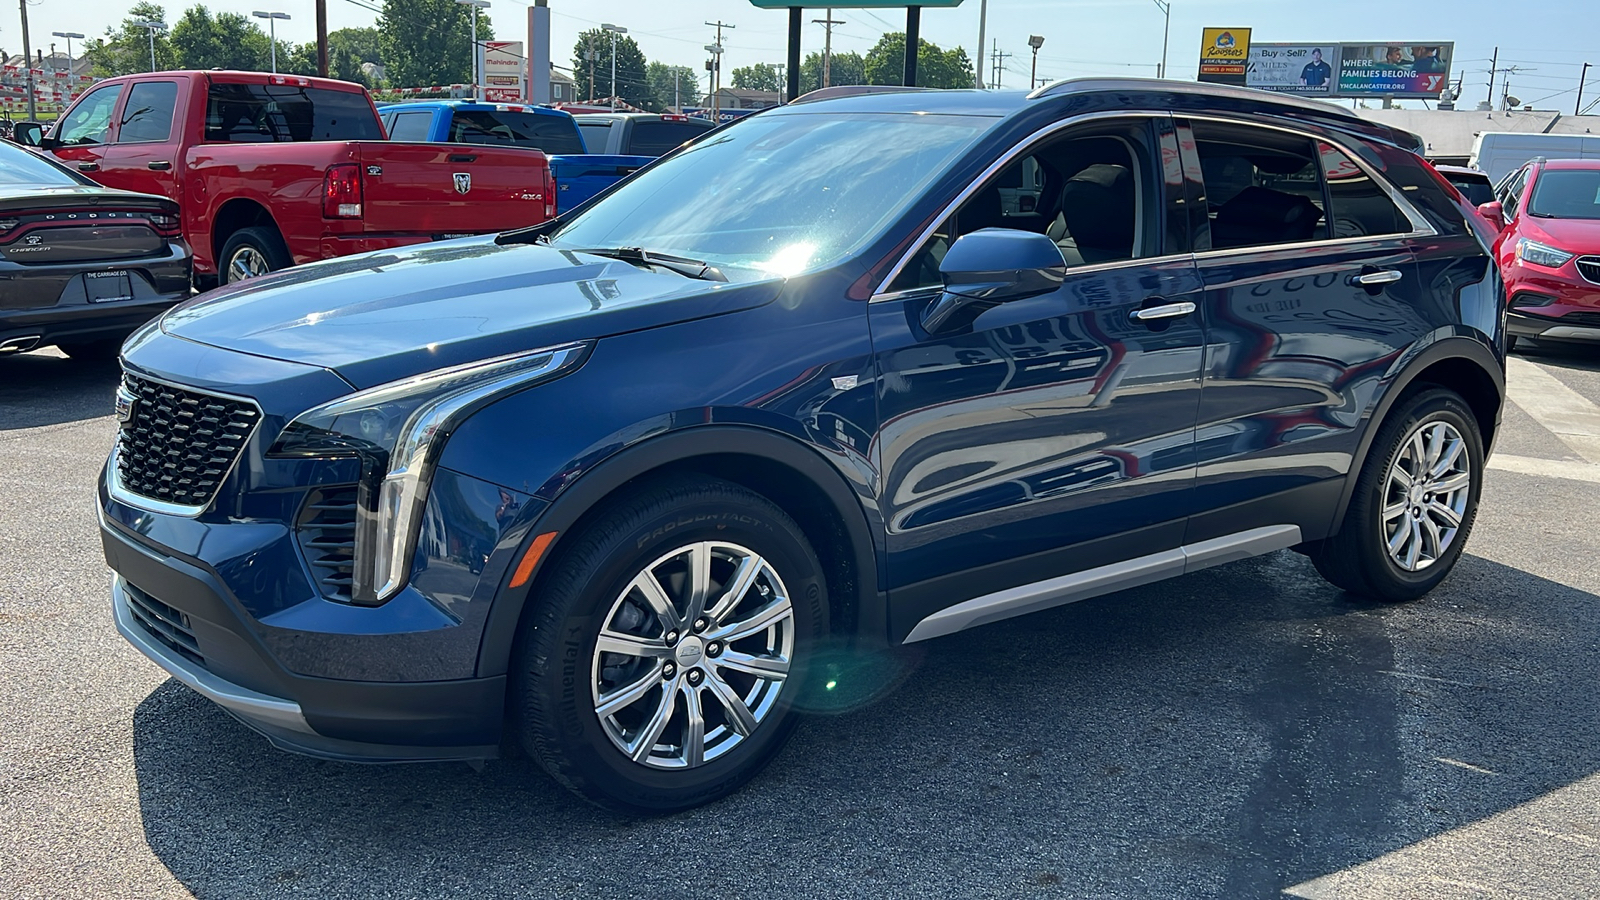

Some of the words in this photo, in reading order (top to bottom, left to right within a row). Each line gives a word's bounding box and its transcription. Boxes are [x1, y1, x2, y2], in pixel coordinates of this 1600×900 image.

[1206, 46, 1243, 57] Roosters
[1261, 50, 1279, 59] Buy
[1287, 50, 1308, 58] Sell?
[1341, 70, 1380, 78] FAMILIES
[1381, 70, 1419, 78] BELONG.
